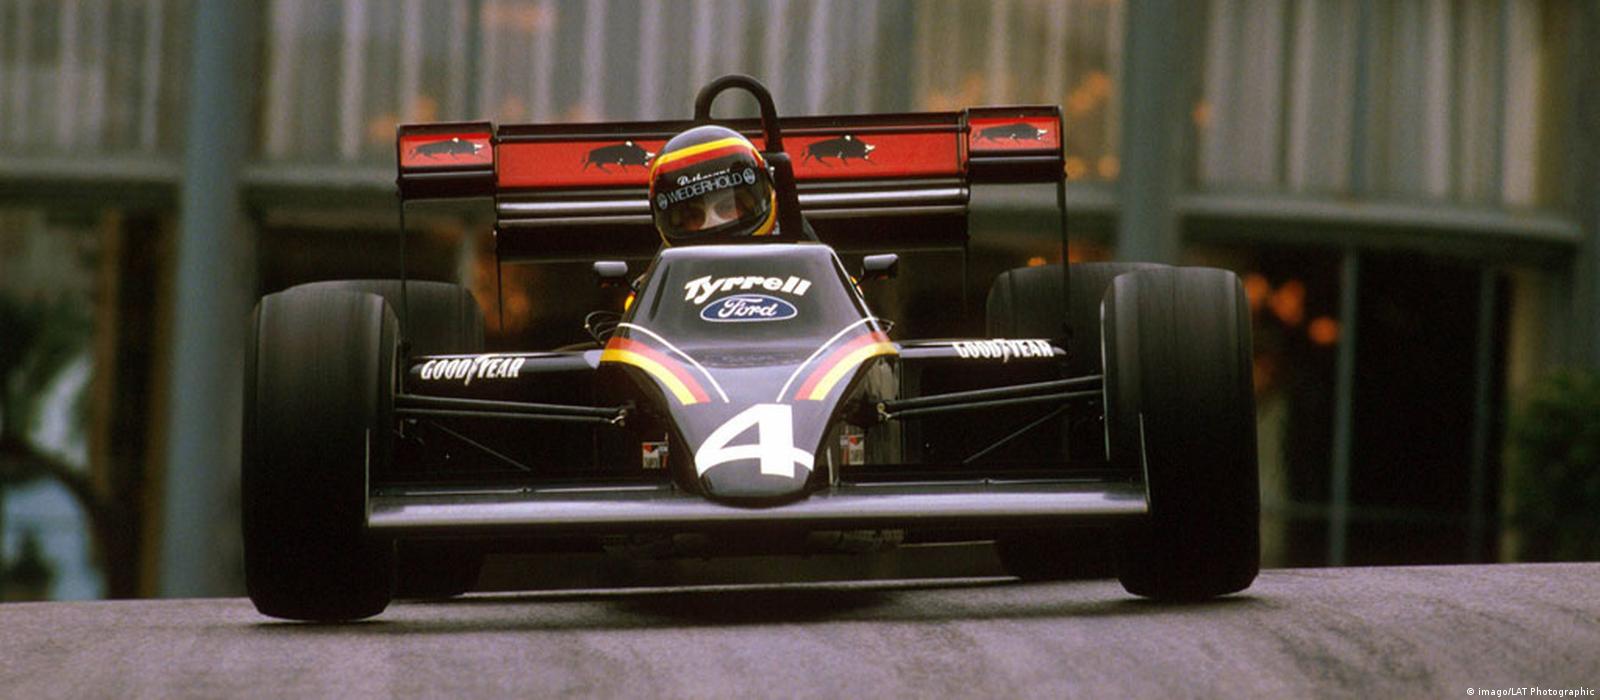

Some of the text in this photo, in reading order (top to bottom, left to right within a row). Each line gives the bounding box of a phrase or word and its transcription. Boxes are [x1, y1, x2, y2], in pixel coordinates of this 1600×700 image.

[684, 274, 812, 305] Tyrrell
[718, 298, 778, 318] Ford
[694, 403, 815, 479] 4
